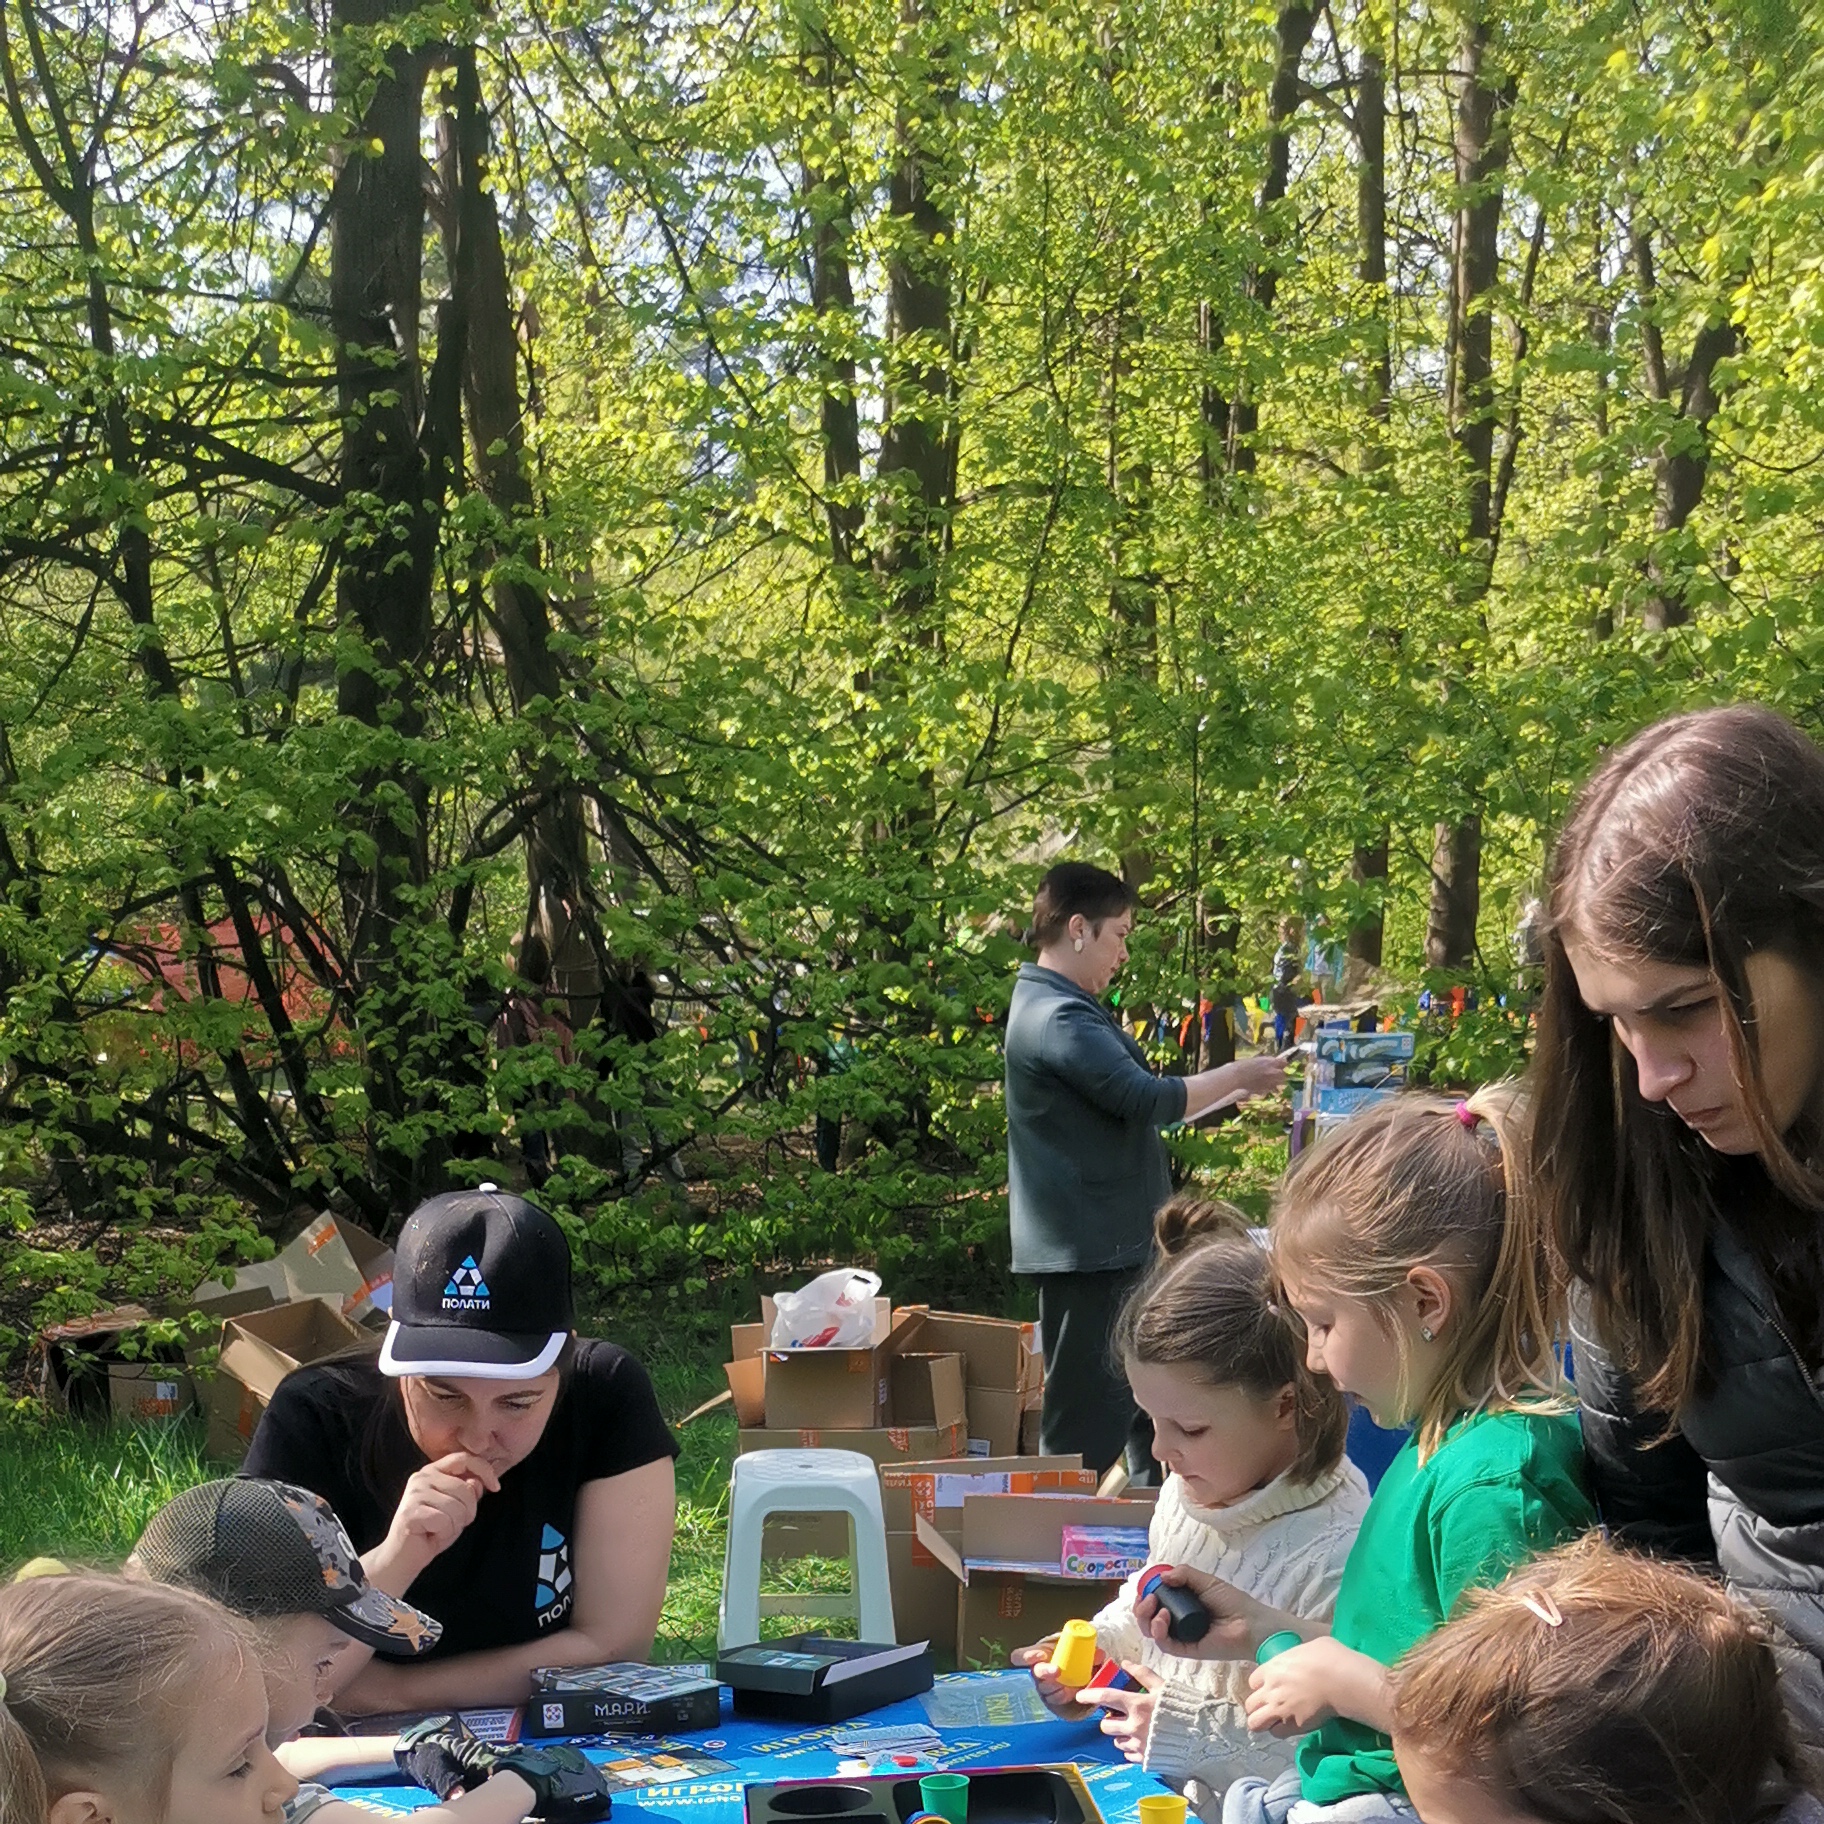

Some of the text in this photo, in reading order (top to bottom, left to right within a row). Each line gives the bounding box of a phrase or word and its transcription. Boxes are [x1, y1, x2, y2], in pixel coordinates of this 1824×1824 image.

[442, 1298, 490, 1309] ПОЛАТИ
[538, 1594, 572, 1628] ПОЛ
[648, 1782, 743, 1797] ИГРО
